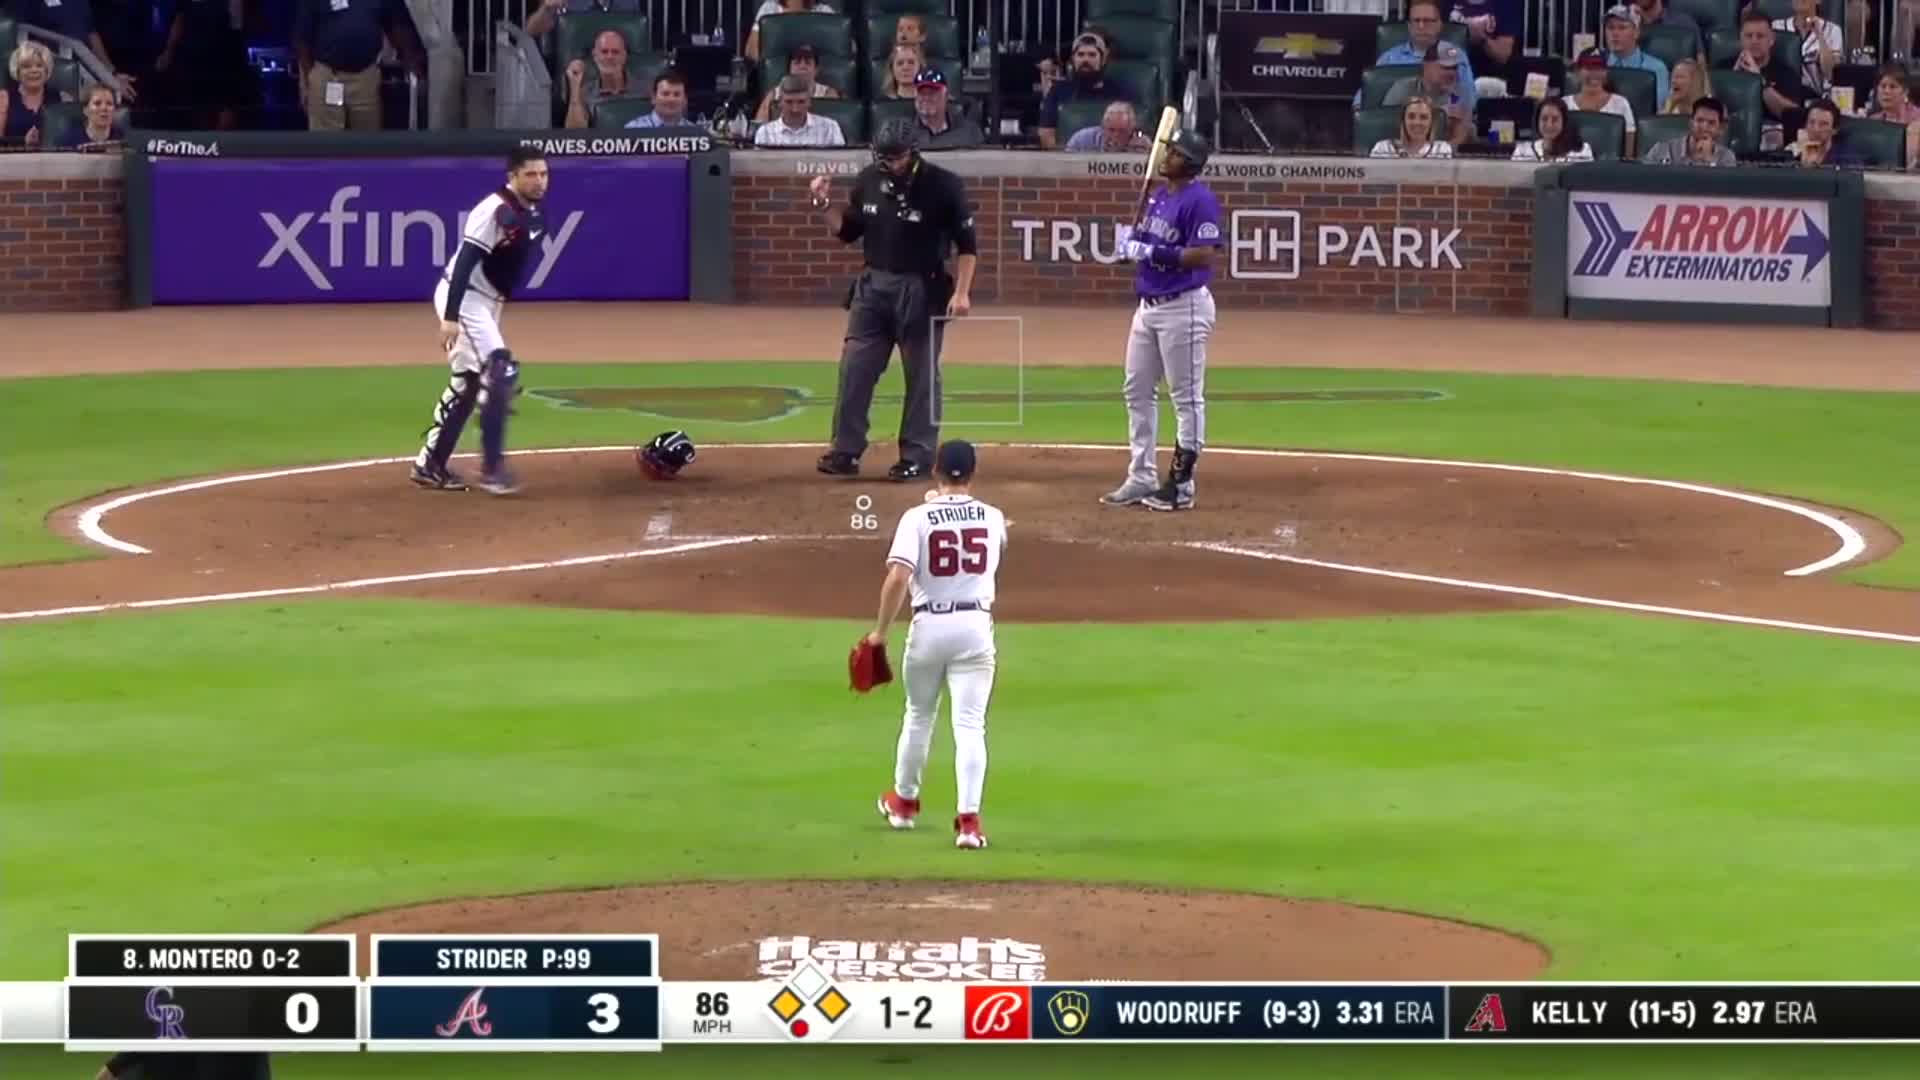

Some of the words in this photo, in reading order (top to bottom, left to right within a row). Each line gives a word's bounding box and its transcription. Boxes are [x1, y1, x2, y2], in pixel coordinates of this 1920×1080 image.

[1252, 64, 1346, 78] CHEVROLET
[796, 160, 859, 174] braves
[1088, 162, 1131, 175] HOME
[1226, 165, 1276, 177] WORLD
[1280, 165, 1366, 179] CHAMPIONS
[257, 186, 585, 290] xfiny
[1632, 203, 1800, 254] ARROW
[1318, 224, 1462, 270] PARK
[1625, 255, 1793, 283] EXTERMINATORS
[929, 528, 988, 577] 65
